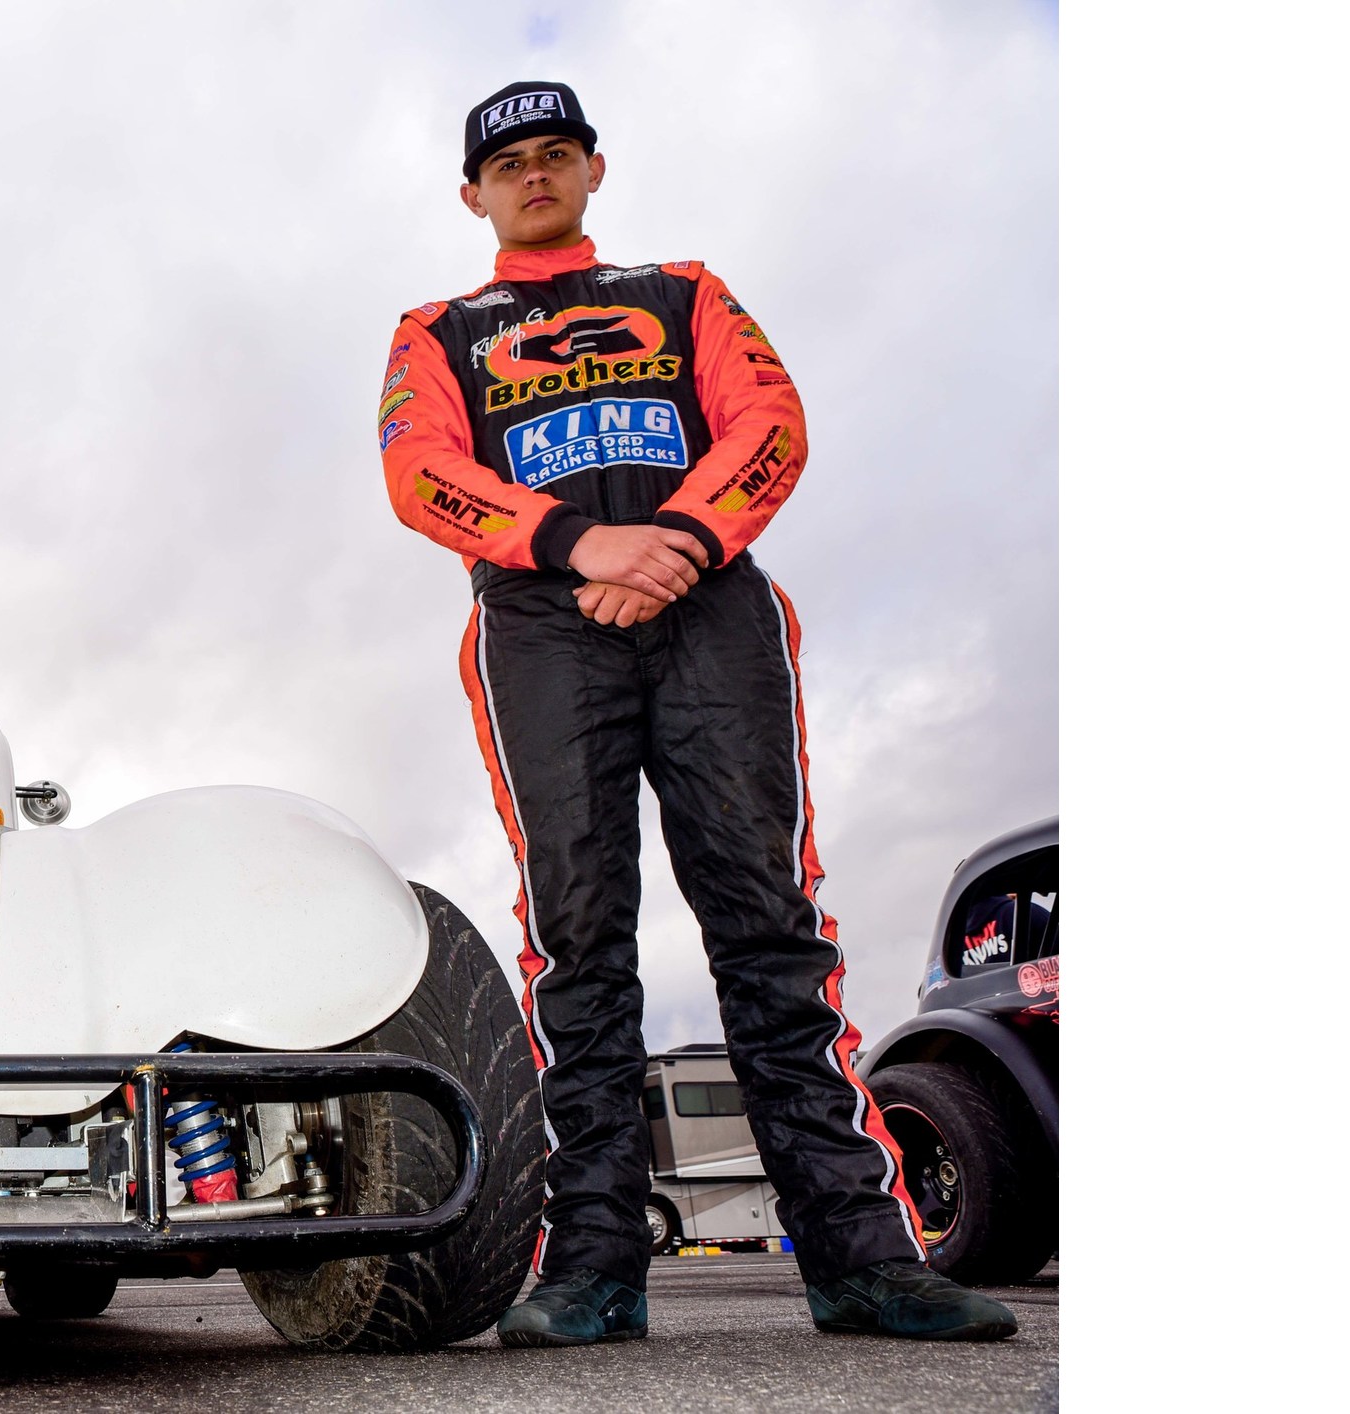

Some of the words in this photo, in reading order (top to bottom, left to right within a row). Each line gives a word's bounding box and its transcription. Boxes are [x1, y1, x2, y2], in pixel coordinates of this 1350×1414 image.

[487, 95, 555, 126] KING
[470, 320, 526, 369] Ricky
[525, 307, 547, 326] G
[486, 354, 681, 413] Brothers
[521, 404, 672, 459] KING
[541, 435, 644, 465] OFF-ROAD
[525, 451, 597, 486] RACING
[606, 447, 678, 462] SHOCKS
[739, 446, 782, 498] M/T
[432, 489, 490, 526] M/T
[457, 487, 518, 517] THOMPSON
